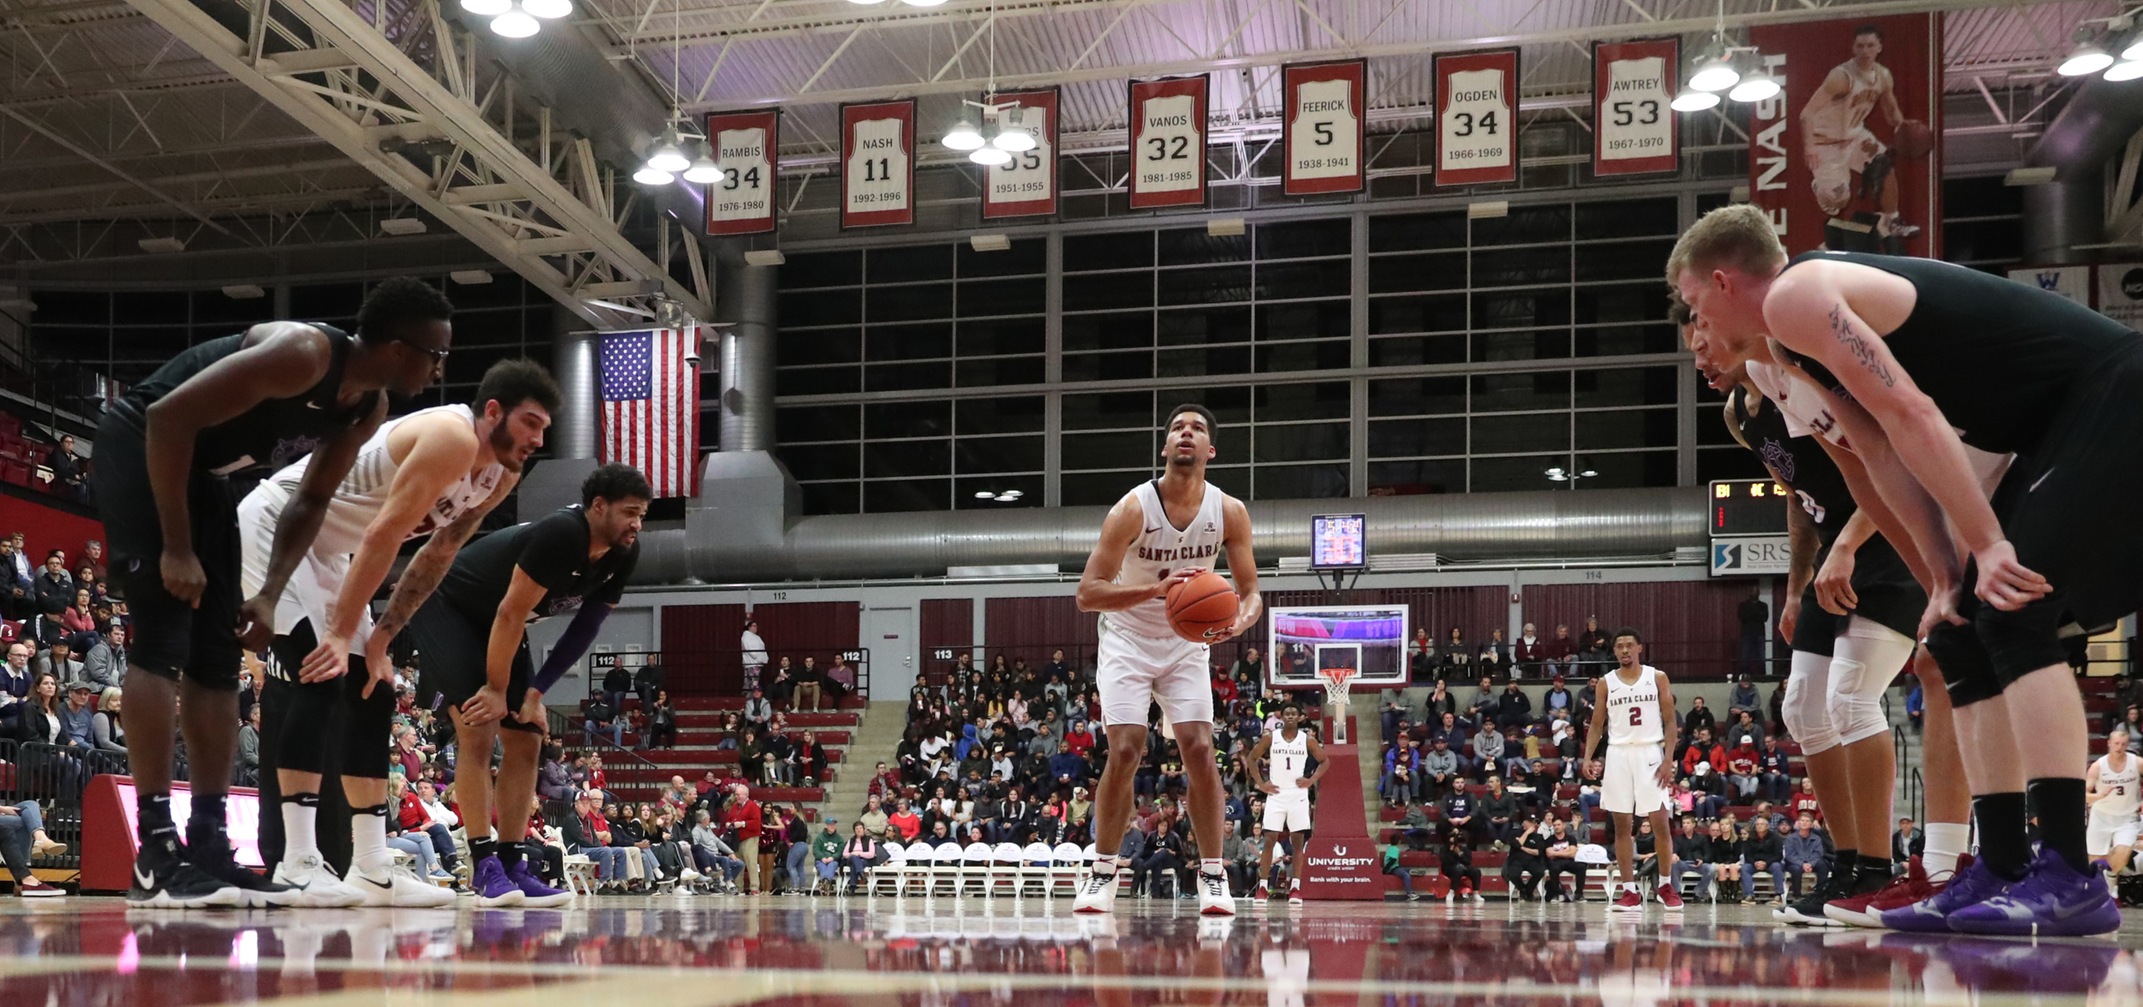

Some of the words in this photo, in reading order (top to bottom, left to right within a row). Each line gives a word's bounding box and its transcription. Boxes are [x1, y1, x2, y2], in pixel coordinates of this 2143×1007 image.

[1613, 77, 1659, 92] AWTREY
[1455, 90, 1497, 103] OGDEN
[1302, 100, 1345, 113] FEERICK
[1612, 100, 1659, 127] 53
[1149, 115, 1187, 128] VANOS
[1454, 110, 1498, 137] 34
[1314, 121, 1333, 146] 5
[863, 138, 893, 149] NASH
[1148, 135, 1188, 161] 32
[1608, 136, 1664, 150] 1967-1970
[722, 146, 761, 159] RAMBIS
[1449, 147, 1503, 160] 1966-1969
[1298, 157, 1349, 169] 1938-1941
[864, 158, 890, 182] 11
[723, 166, 760, 191] 34
[1143, 171, 1192, 183] 1981-1985
[996, 181, 1044, 193] 1951-1955
[853, 191, 901, 204] 1992-1996
[719, 200, 764, 212] 1976-1980
[1138, 546, 1178, 562] SANTA
[1747, 543, 1792, 561] SRS
[1585, 570, 1602, 580] 114
[773, 591, 787, 601] 112
[598, 656, 615, 665] 112
[843, 651, 860, 661] 112
[934, 650, 952, 659] 113
[1609, 696, 1633, 707] SANTA
[1629, 706, 1642, 726] 2
[1286, 756, 1291, 770] 1
[2116, 785, 2125, 796] 3
[1307, 857, 1374, 866] UNIVERSITY
